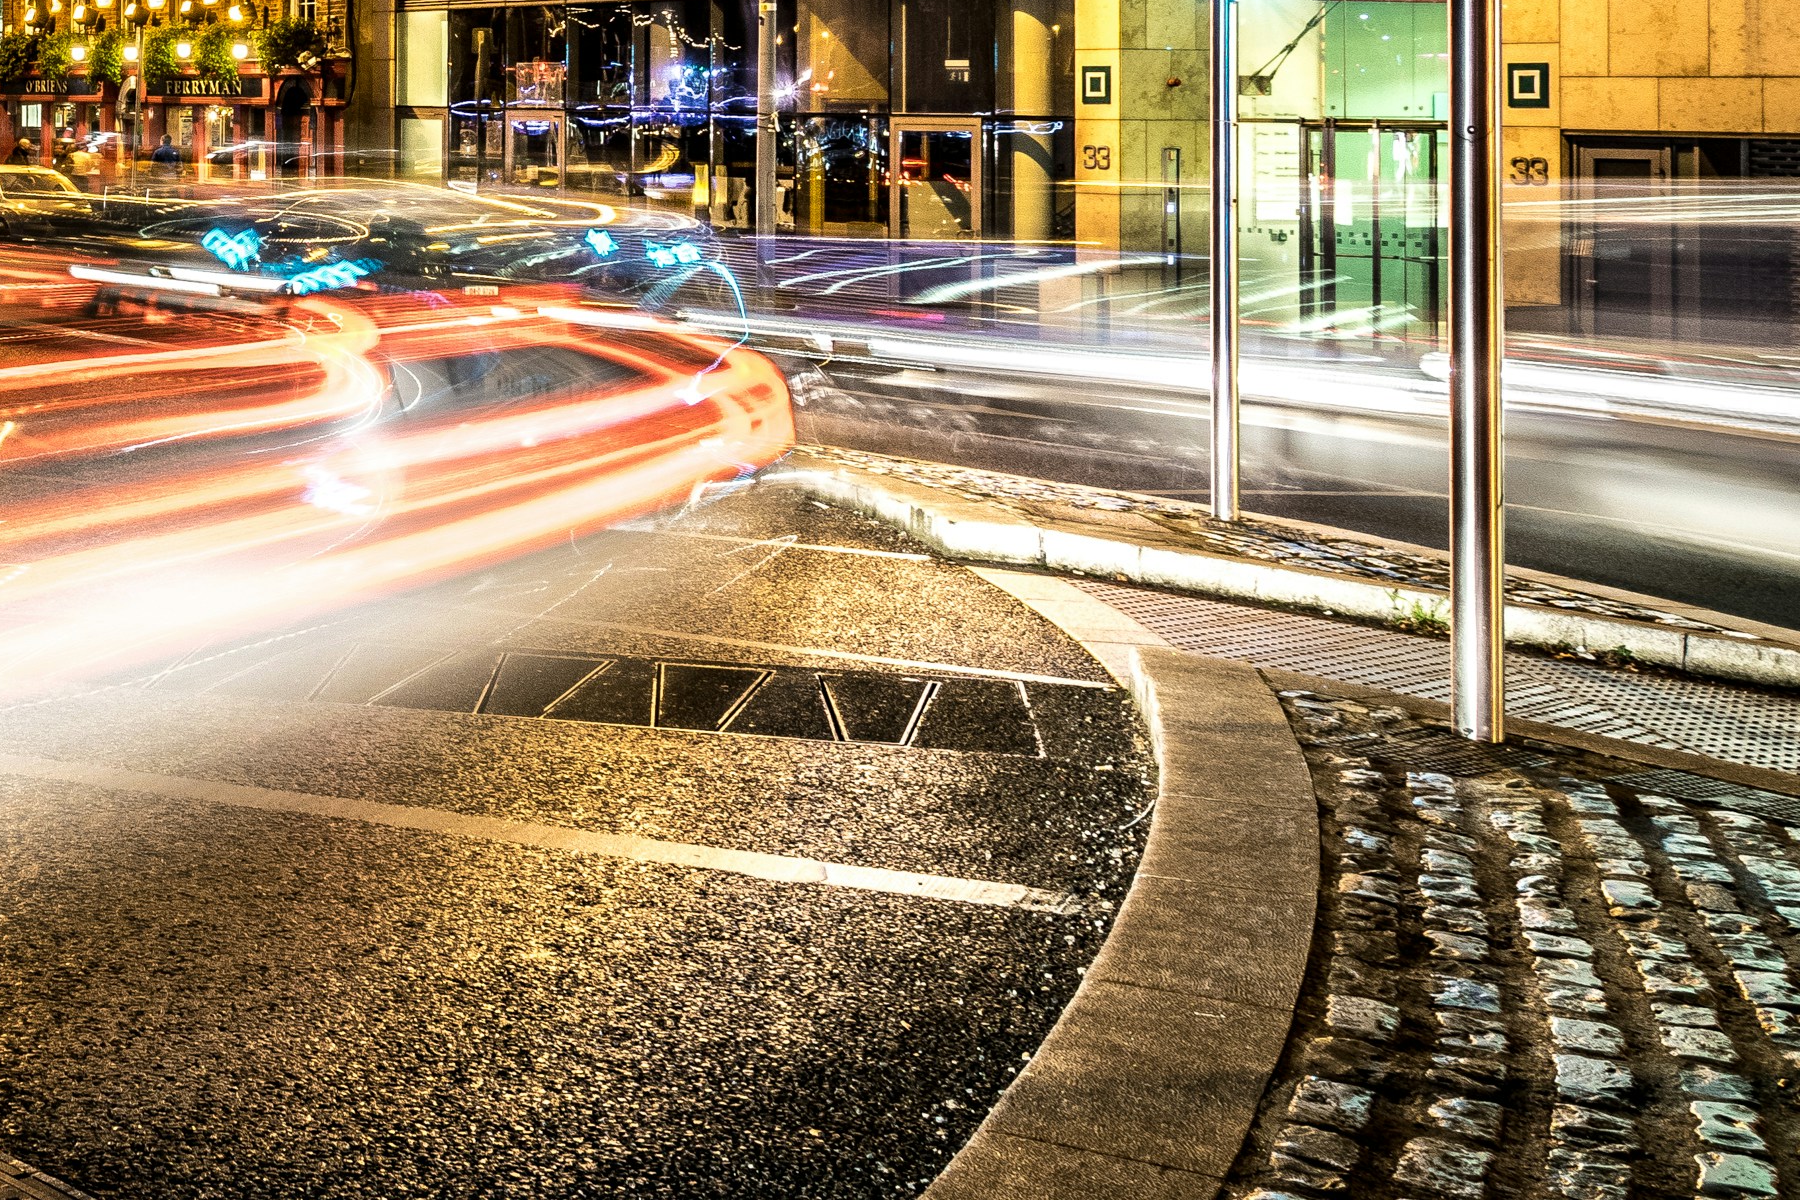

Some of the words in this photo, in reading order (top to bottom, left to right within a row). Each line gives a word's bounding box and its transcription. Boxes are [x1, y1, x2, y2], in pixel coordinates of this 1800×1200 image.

[25, 79, 68, 93] O'BRIENS
[166, 80, 242, 95] FERRYMAN
[1083, 145, 1110, 170] 33
[1510, 156, 1549, 186] 33
